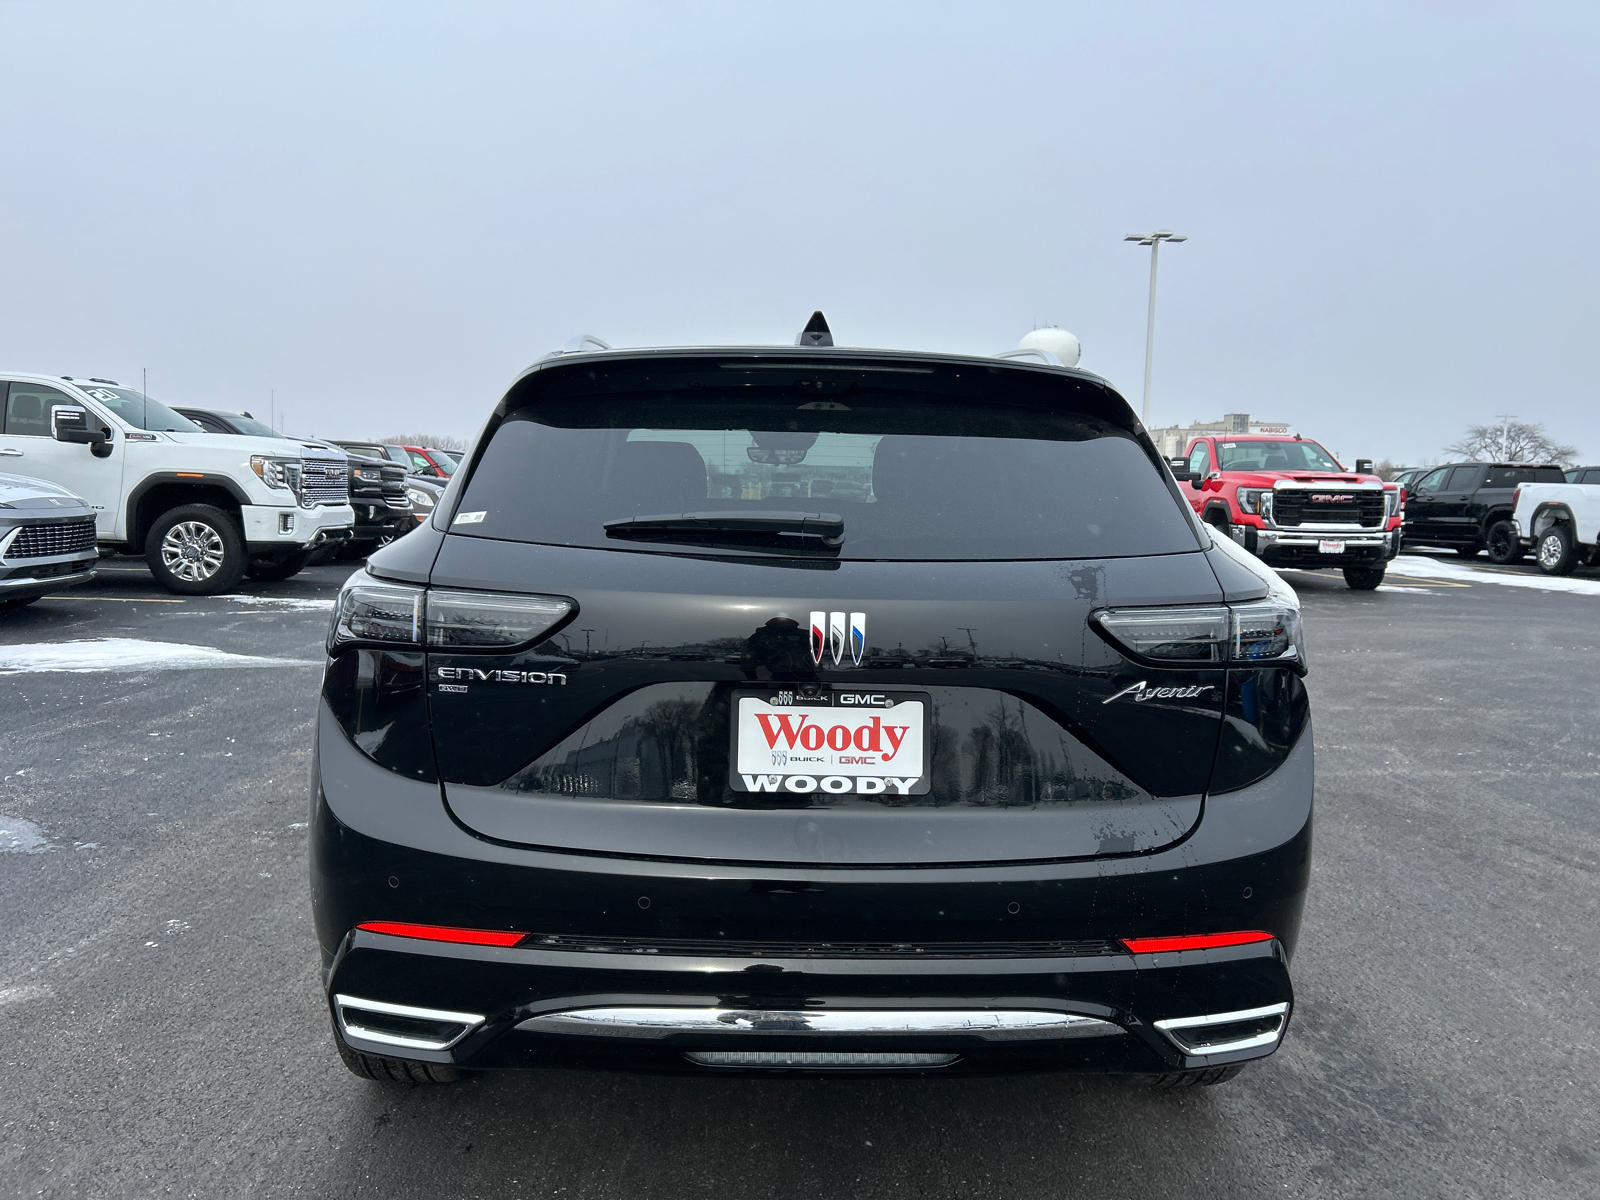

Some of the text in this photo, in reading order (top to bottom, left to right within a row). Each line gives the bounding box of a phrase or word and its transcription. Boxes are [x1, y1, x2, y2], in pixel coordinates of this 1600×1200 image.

[1311, 494, 1354, 503] GMC
[437, 666, 567, 686] ENVISION
[840, 694, 885, 705] GMC
[1102, 680, 1215, 704] Avenir
[754, 713, 910, 762] Woody
[838, 755, 876, 765] GMC
[741, 774, 920, 795] WOODY
